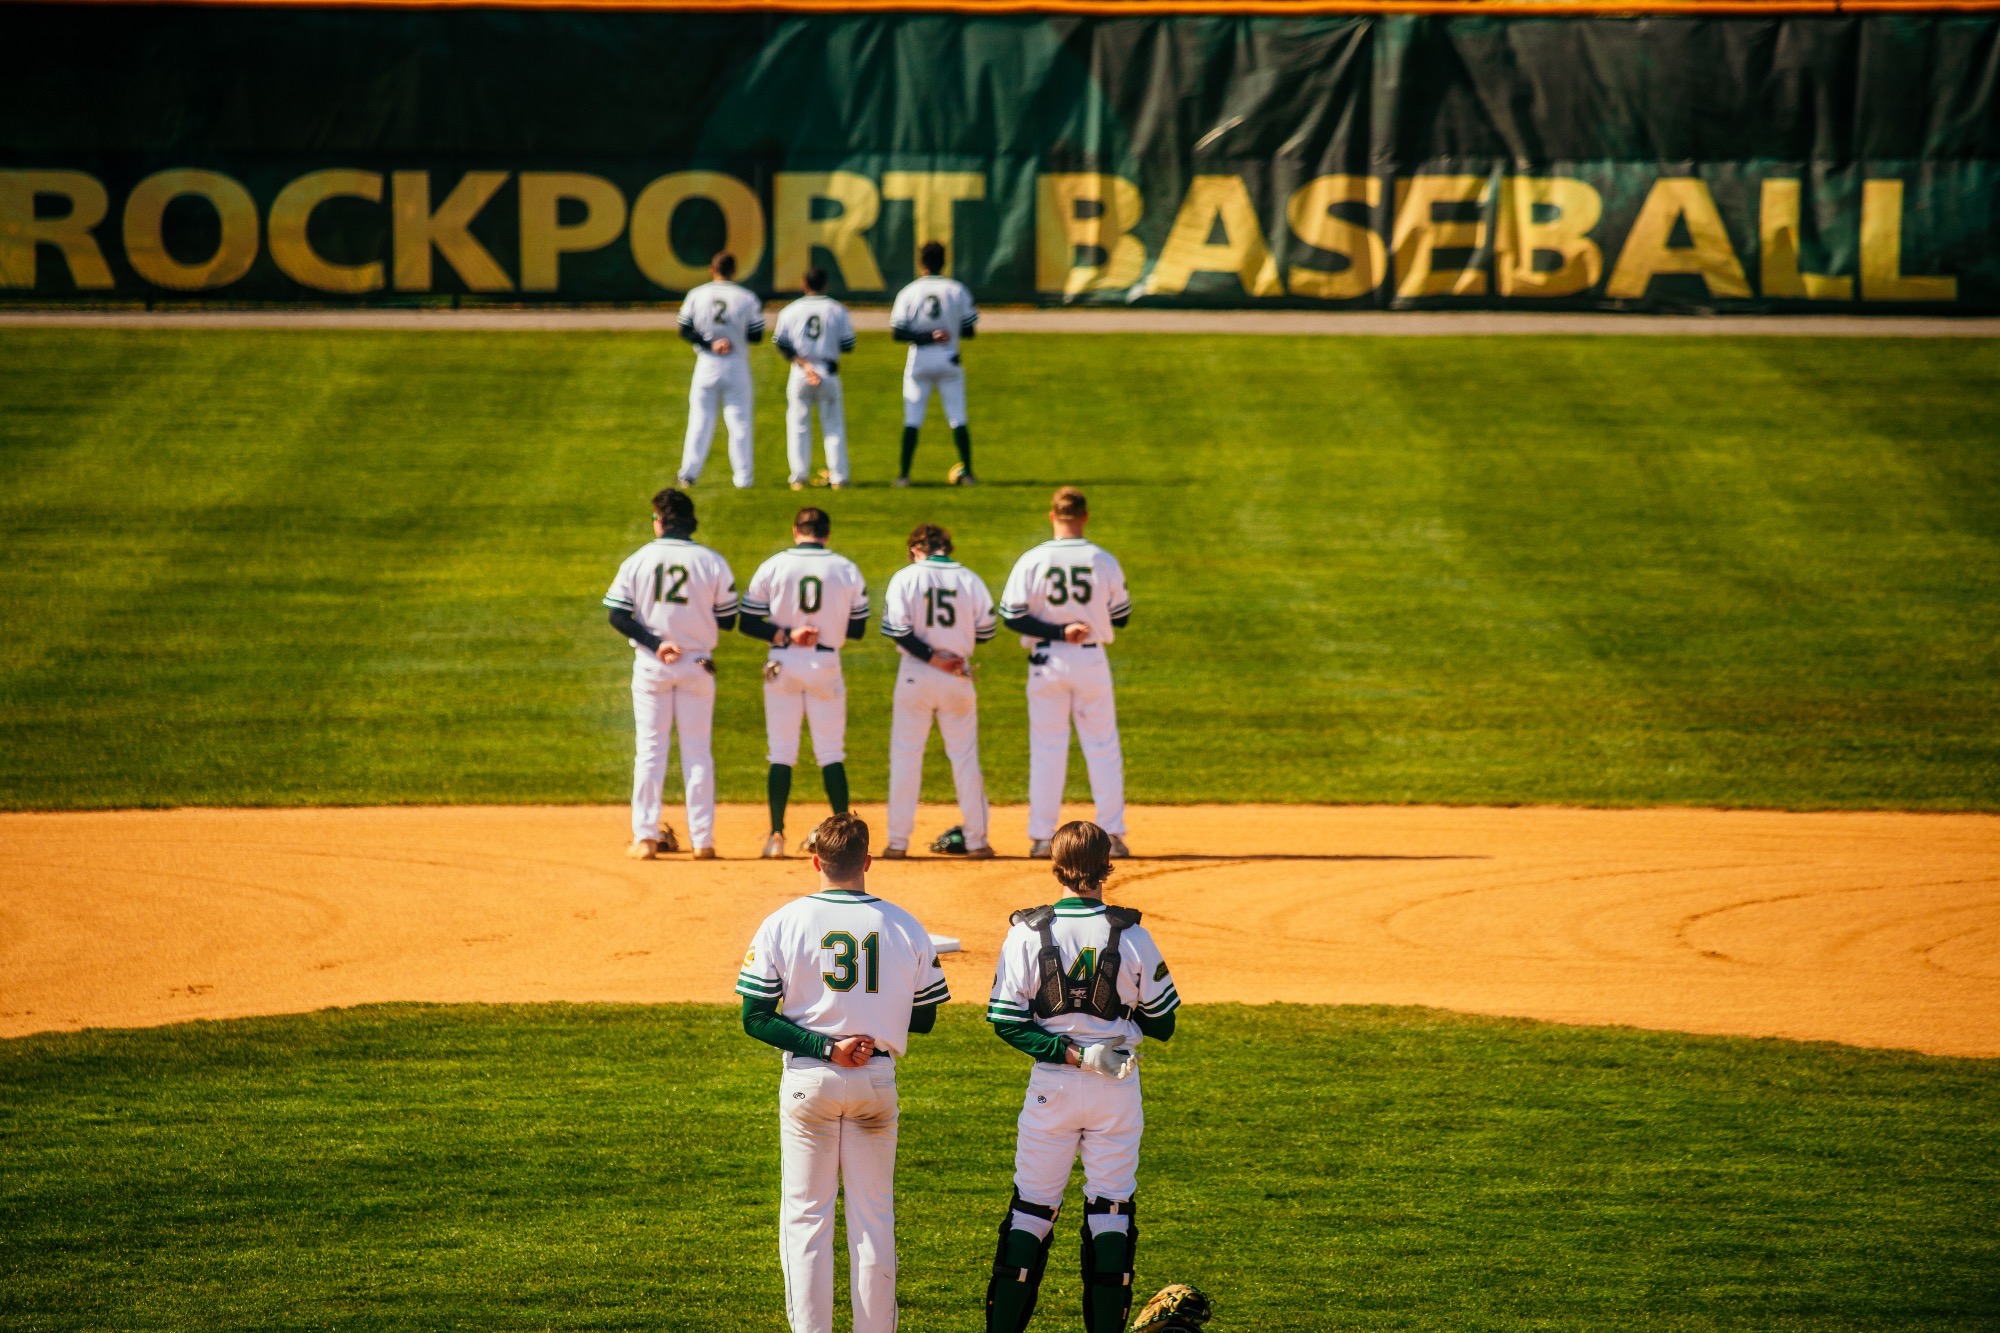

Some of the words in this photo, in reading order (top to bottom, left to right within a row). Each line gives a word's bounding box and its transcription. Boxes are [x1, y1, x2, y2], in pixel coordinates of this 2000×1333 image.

[0, 169, 986, 293] ROCKPORT
[1035, 173, 1958, 302] BASEBALL
[713, 299, 727, 326] 2
[653, 563, 688, 604] 12
[799, 575, 822, 614] 0
[1045, 565, 1093, 606] 35
[924, 586, 956, 628] 15
[820, 930, 880, 994] 31
